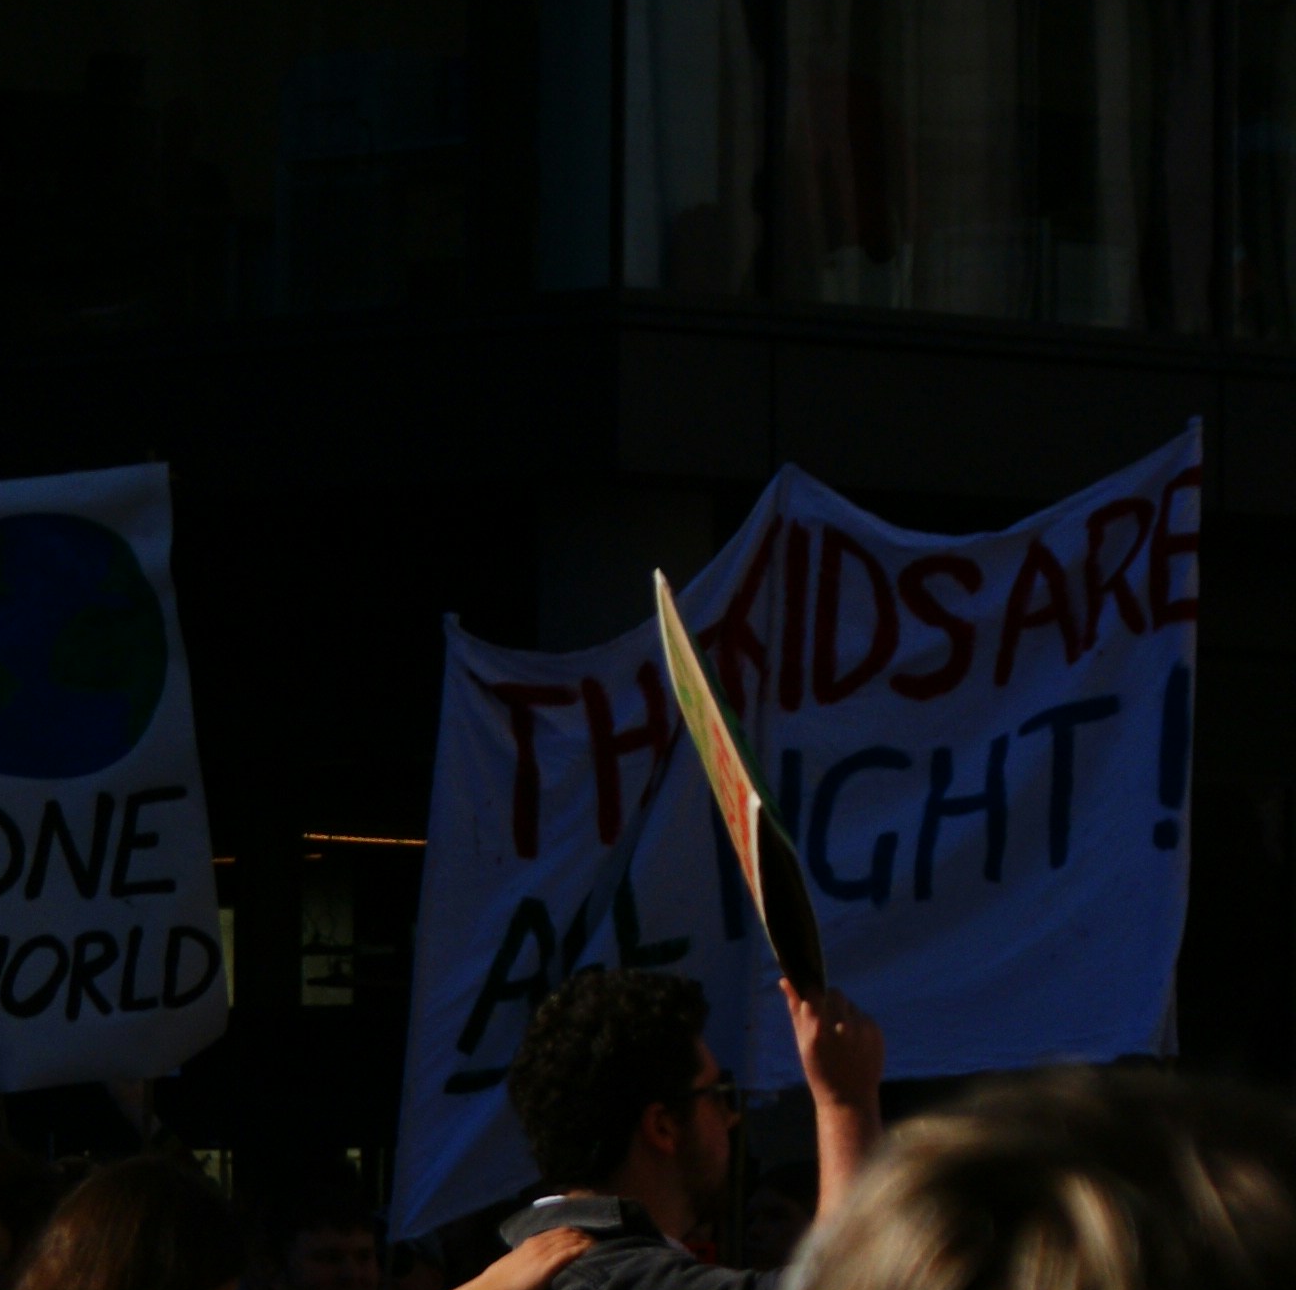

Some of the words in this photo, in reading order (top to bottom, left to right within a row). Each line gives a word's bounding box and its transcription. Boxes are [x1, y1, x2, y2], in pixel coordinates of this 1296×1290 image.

[489, 661, 682, 858] TH
[696, 514, 981, 711] KIDS
[995, 467, 1202, 686] ARE
